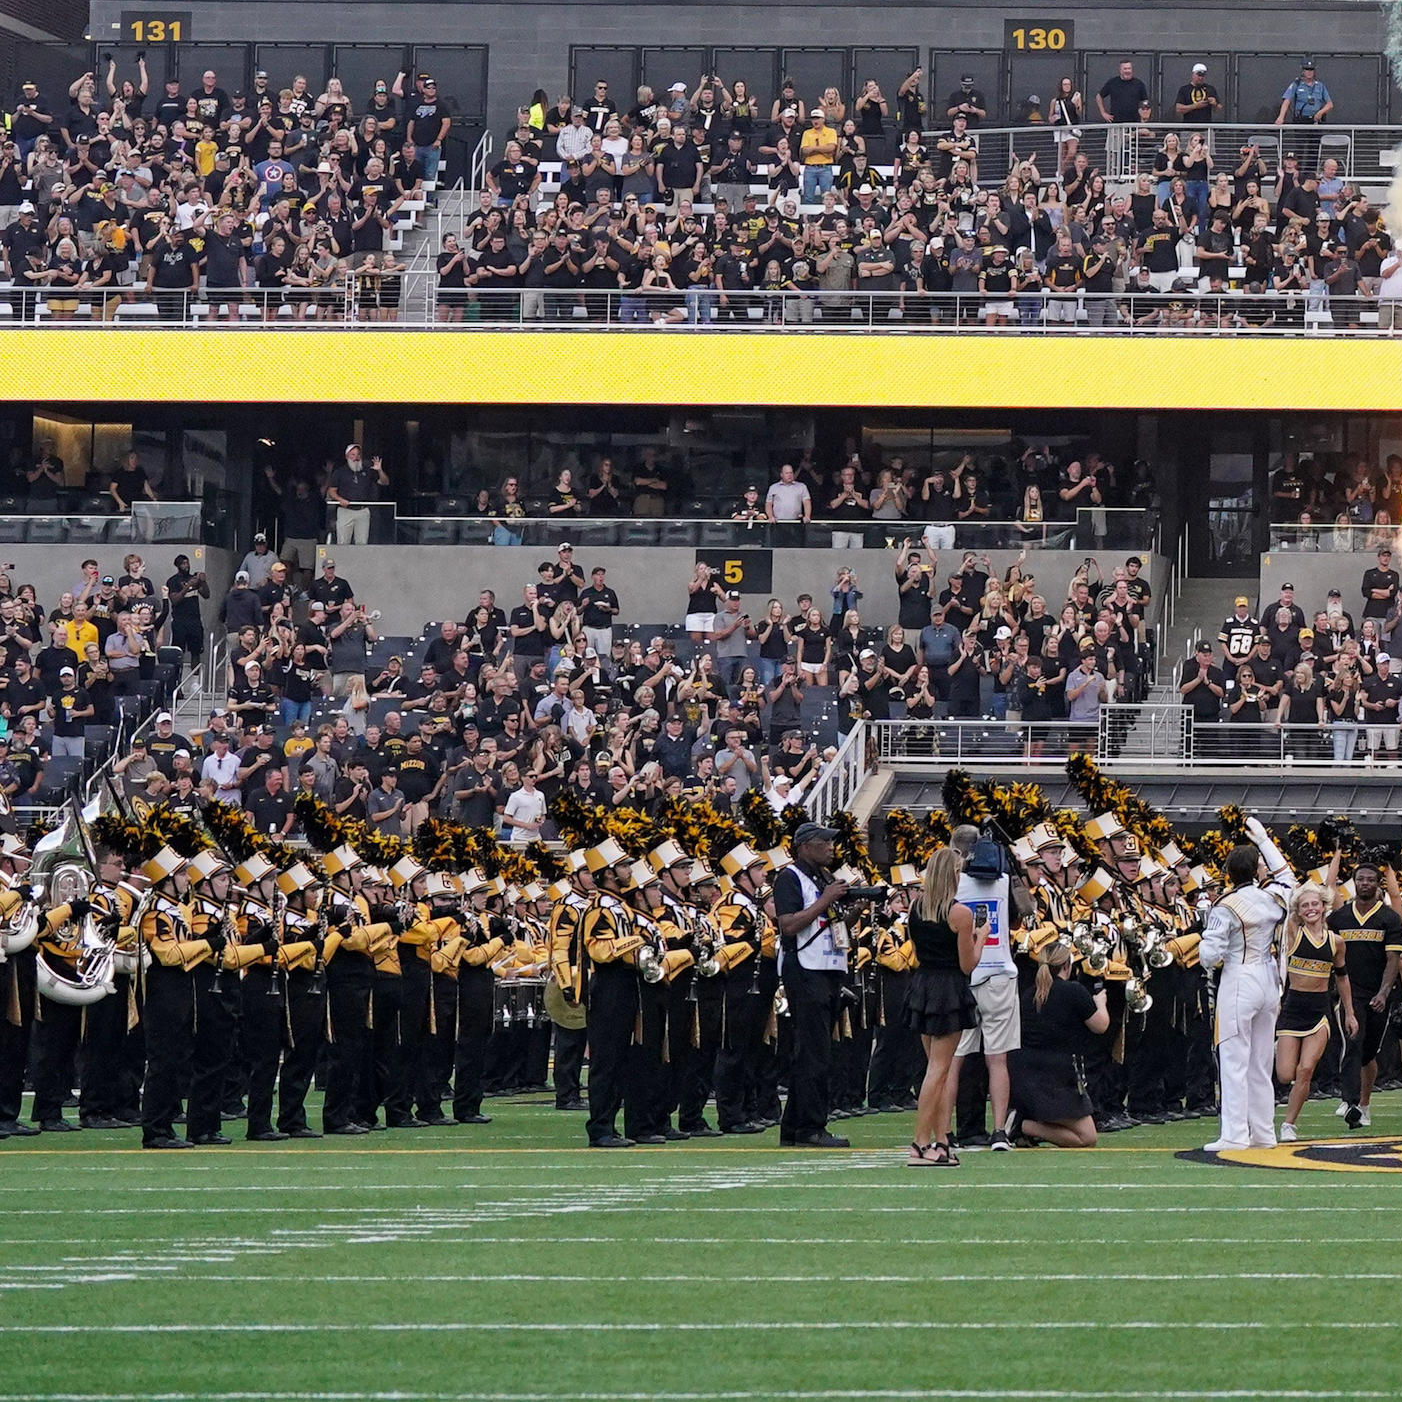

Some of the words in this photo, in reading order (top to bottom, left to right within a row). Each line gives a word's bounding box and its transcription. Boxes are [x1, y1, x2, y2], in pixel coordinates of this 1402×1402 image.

[130, 21, 182, 41] 131
[1012, 28, 1066, 50] 130
[724, 560, 744, 583] 5
[1229, 645, 1254, 665] 68
[400, 760, 425, 771] MIZZOU
